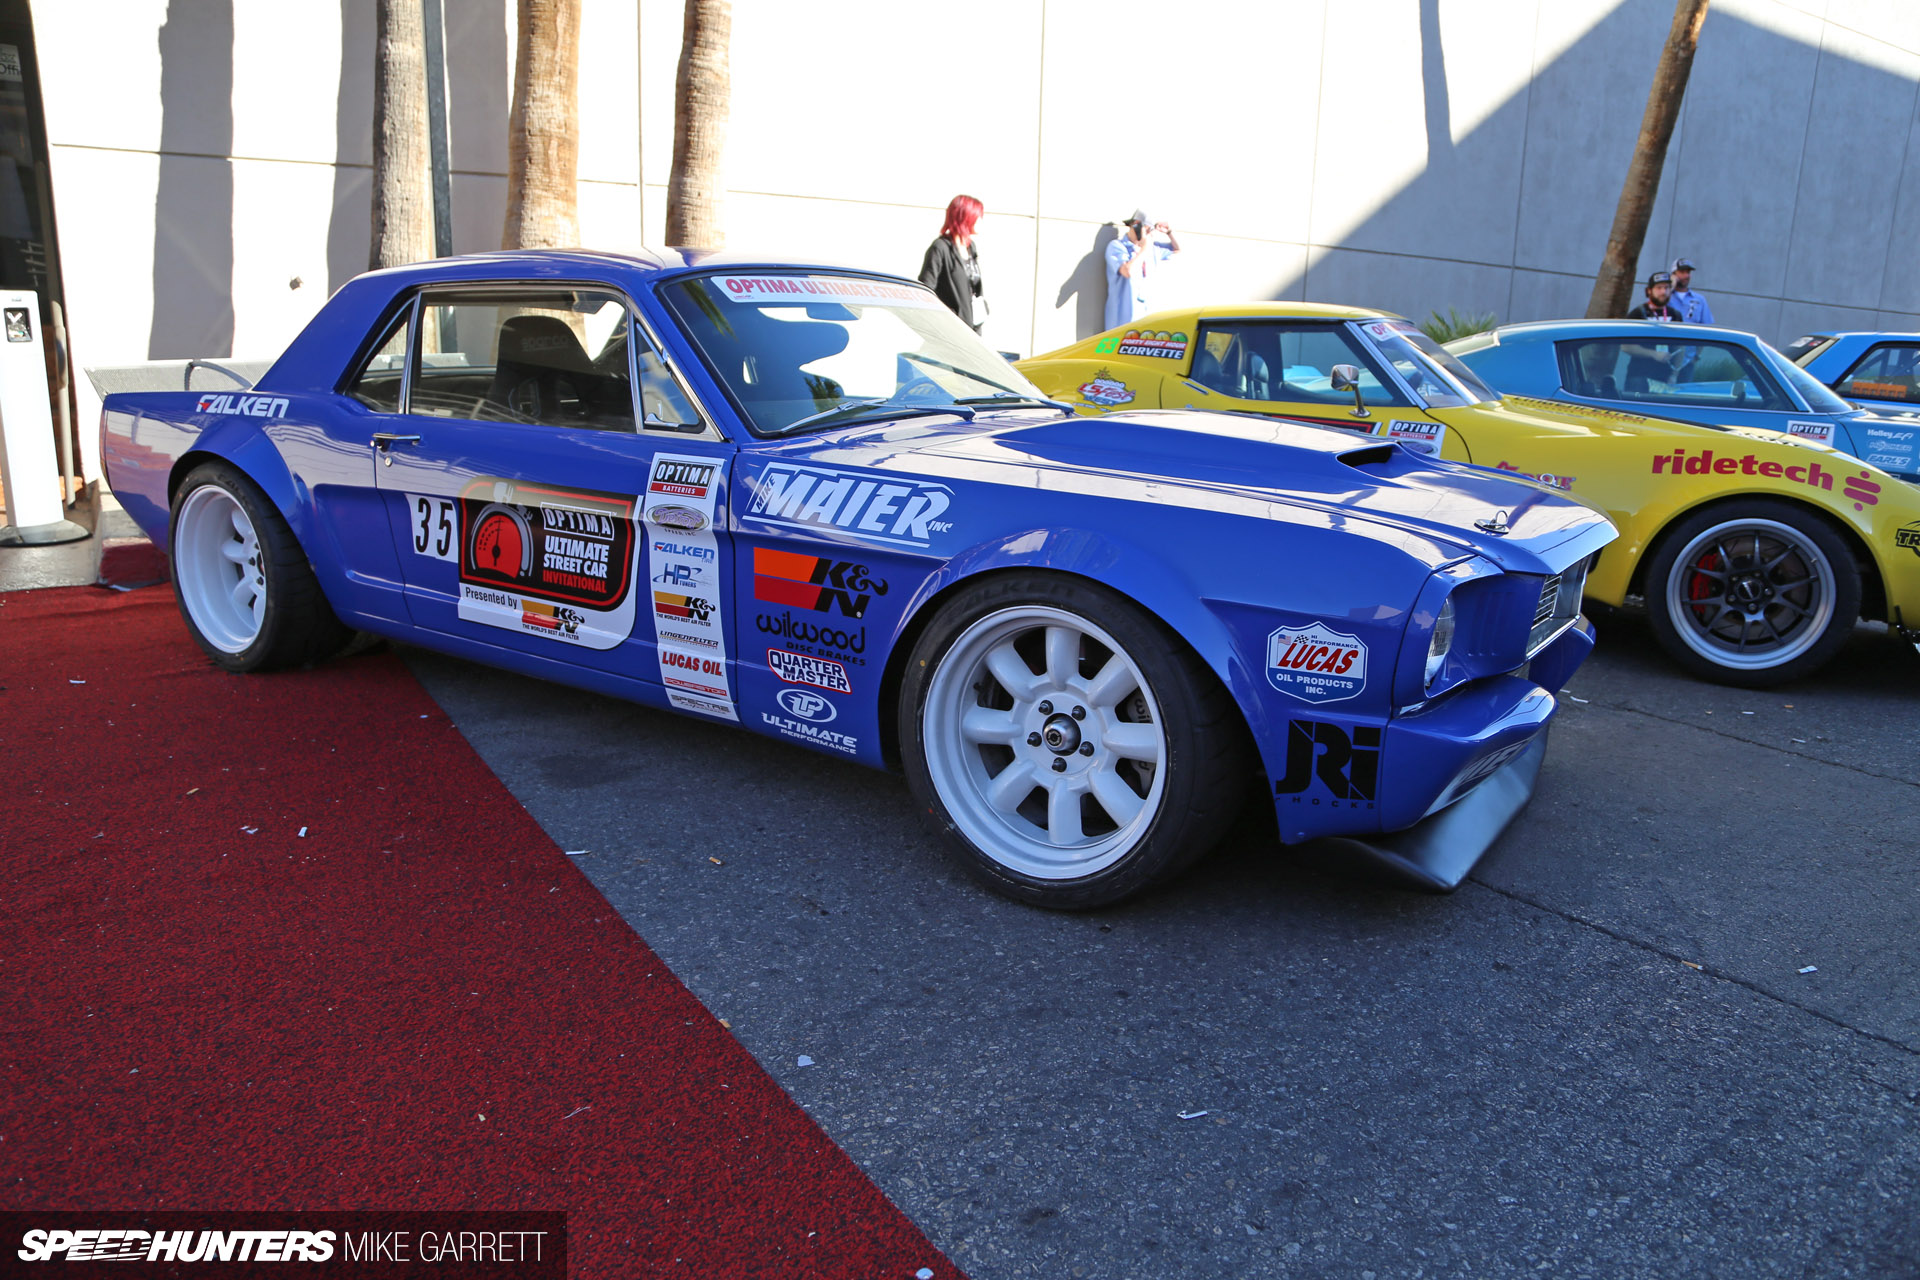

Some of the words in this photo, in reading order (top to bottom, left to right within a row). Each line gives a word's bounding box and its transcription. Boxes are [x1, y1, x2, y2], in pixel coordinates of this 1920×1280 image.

[725, 278, 803, 294] OPTIMA
[804, 280, 876, 298] ULTIMATE
[1095, 337, 1120, 354] 63
[1118, 345, 1184, 359] CORVETTE
[196, 394, 290, 418] FALKEN
[1394, 422, 1438, 434] OPTIMA
[1791, 424, 1829, 435] OPTIMA
[655, 463, 711, 485] OPTIMA
[1652, 448, 1834, 491] ridetech
[662, 485, 696, 495] BATTERIES
[755, 475, 776, 511] MIKE
[751, 471, 950, 539] MAIER
[415, 497, 454, 556] 35
[545, 508, 611, 535] OPTIMA
[928, 520, 953, 533] INC
[545, 535, 610, 562] ULTIMATE
[654, 541, 715, 559] FALKEN
[543, 553, 583, 573] STREET
[583, 561, 608, 578] CAR
[663, 562, 691, 585] HP
[542, 569, 607, 594] INVITATIONAL
[465, 587, 506, 605] Presented
[507, 595, 518, 609] by
[663, 614, 680, 622] WORLD'S
[530, 625, 547, 633] WORLD'S
[565, 633, 580, 641] FILTER
[660, 630, 719, 646] LINGENFELTER
[756, 611, 865, 654] wilwood
[1310, 639, 1358, 649] PERFORMANCE
[662, 651, 699, 671] LUCAS
[702, 660, 722, 676] OIL
[769, 650, 843, 677] QUARTER
[786, 641, 813, 653] DISC
[818, 648, 866, 666] BRAKES
[1277, 642, 1360, 674] LUCAS
[783, 665, 848, 691] MASTER
[1276, 673, 1293, 683] OIL
[1296, 675, 1354, 689] PRODUCTS
[1305, 686, 1327, 695] INC.
[761, 711, 857, 748] ULTIMATE
[780, 728, 857, 755] PERFORMANCE
